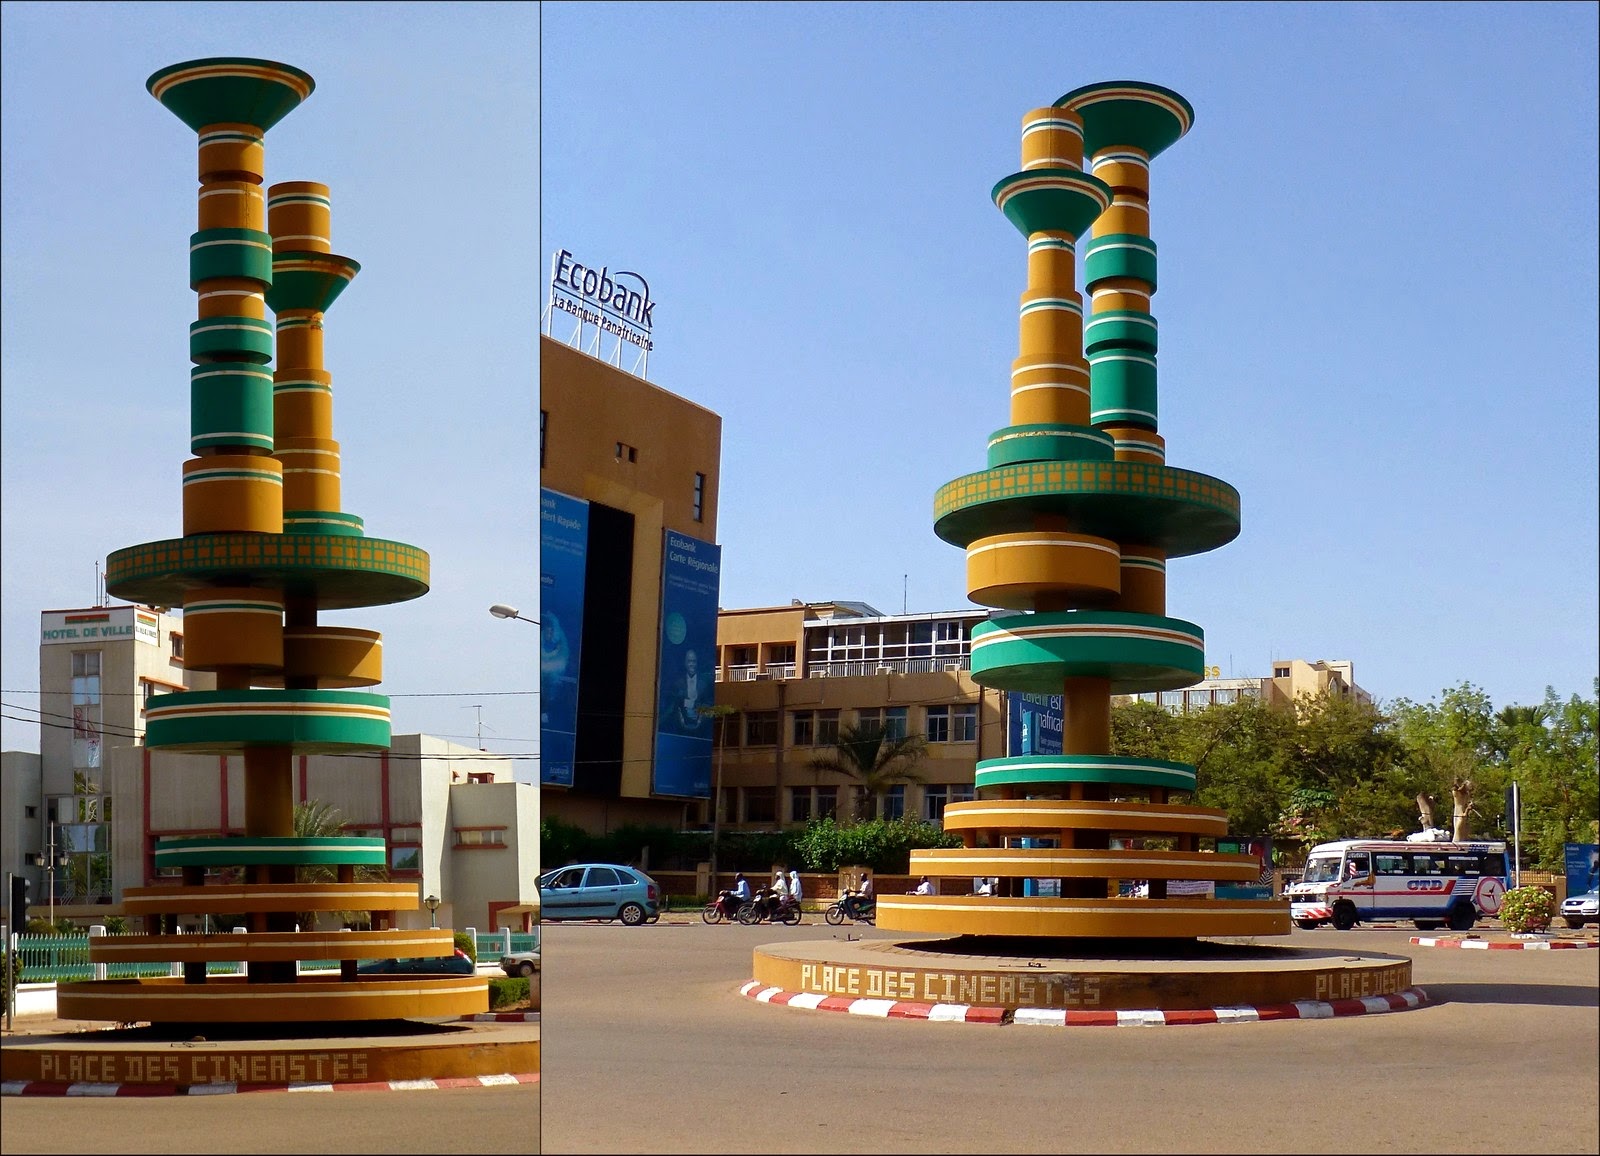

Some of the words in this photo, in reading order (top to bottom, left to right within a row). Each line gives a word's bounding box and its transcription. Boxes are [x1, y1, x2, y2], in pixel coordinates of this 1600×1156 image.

[555, 249, 656, 328] Ecobank
[554, 293, 565, 308] La
[566, 299, 600, 324] Banque
[600, 315, 653, 351] Panafricaine
[670, 536, 697, 553] Ecobank
[670, 551, 687, 564] Carte
[43, 628, 79, 639] HOTEL
[83, 627, 98, 637] DE
[100, 625, 133, 636] VILLE
[1050, 694, 1062, 711] est
[801, 964, 860, 994] PLACE
[866, 969, 916, 999] DES
[924, 973, 1101, 1005] CINEASTES
[1315, 971, 1370, 1000] PLACE
[1373, 968, 1396, 995] DES
[40, 1054, 116, 1081] PLACE
[123, 1056, 180, 1082] DES
[191, 1053, 368, 1081] CINEASTES
